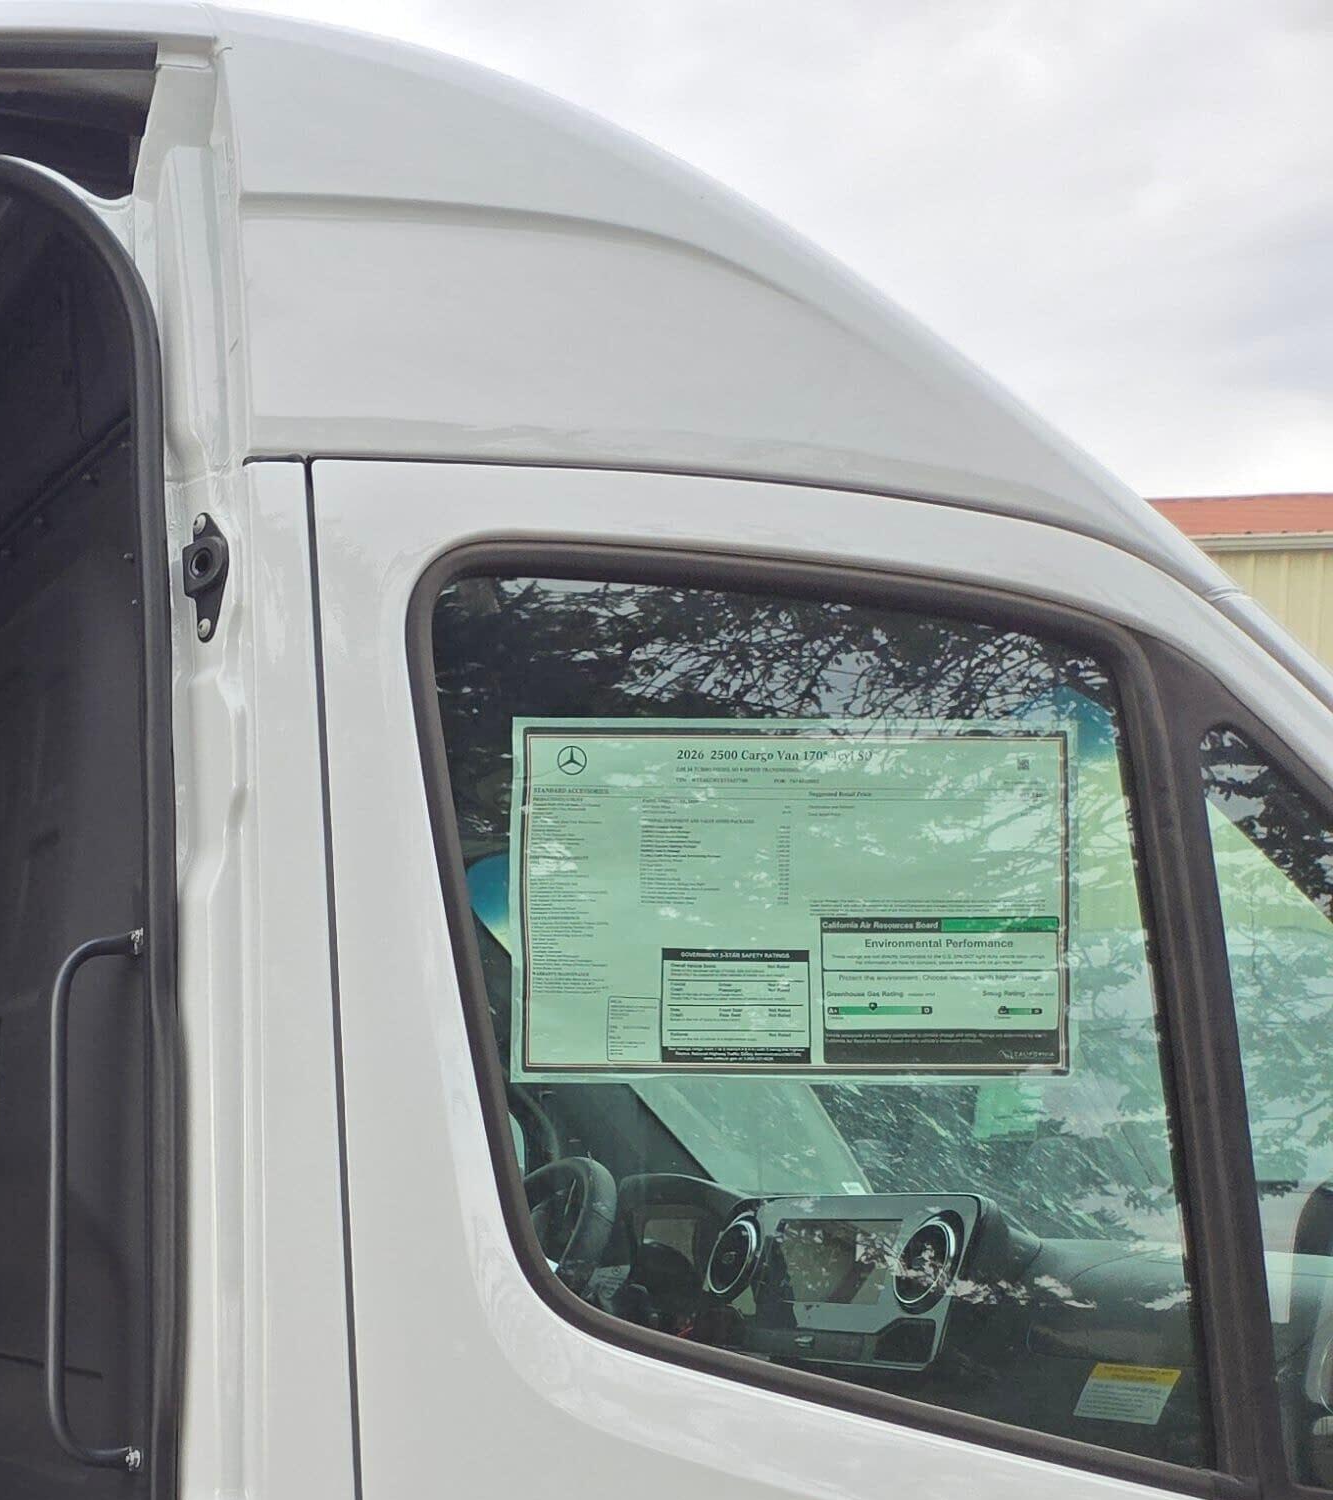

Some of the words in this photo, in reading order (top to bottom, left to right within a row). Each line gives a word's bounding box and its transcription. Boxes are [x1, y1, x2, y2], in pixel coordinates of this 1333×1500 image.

[677, 750, 704, 760] 2026
[710, 750, 738, 760] 2500
[741, 750, 774, 762] Cargo
[777, 750, 799, 761] Van
[821, 921, 858, 930] California
[860, 921, 871, 930] Air
[873, 921, 913, 930] Resources
[915, 921, 939, 930] Board
[865, 938, 943, 948] Environmental
[945, 938, 1014, 948] Performance
[826, 990, 865, 998] Greenhouse
[867, 990, 880, 998] Gas
[882, 990, 904, 999] Rating
